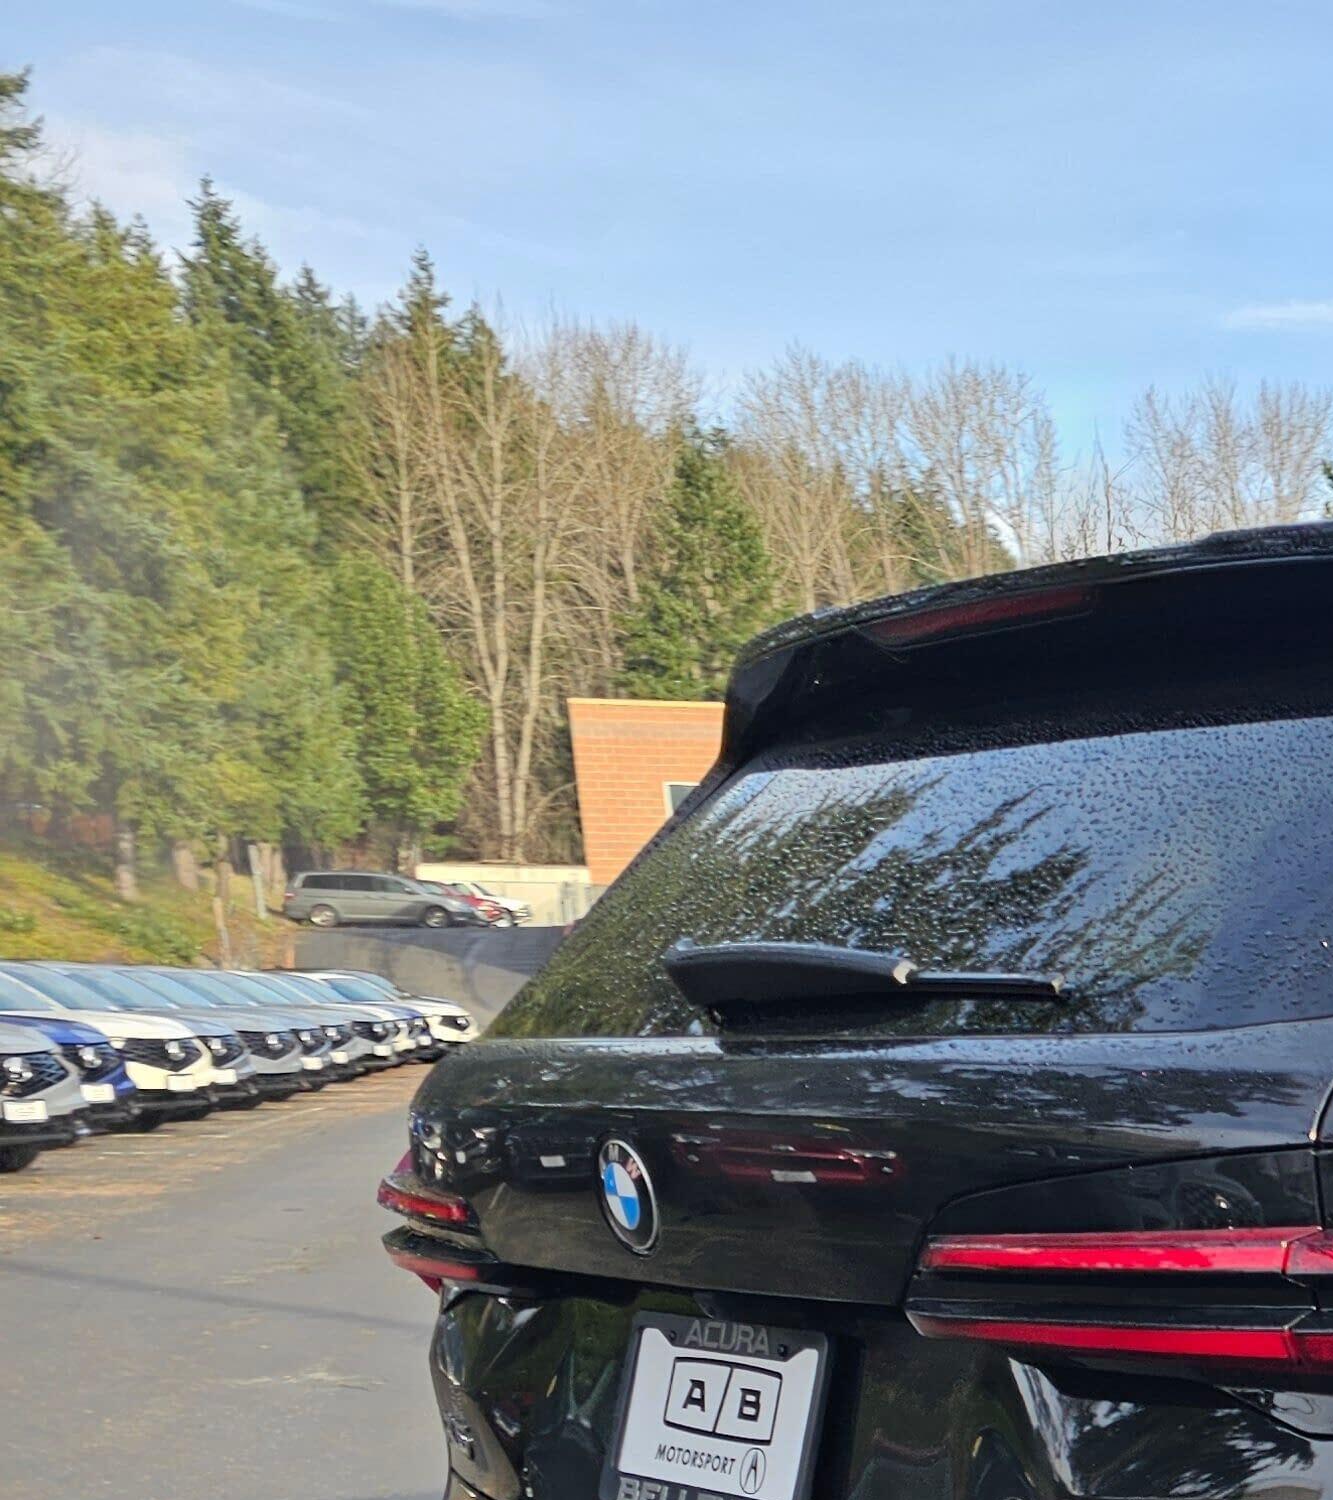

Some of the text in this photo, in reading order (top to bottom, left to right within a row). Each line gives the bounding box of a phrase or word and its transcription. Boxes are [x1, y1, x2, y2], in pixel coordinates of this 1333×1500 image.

[684, 1319, 770, 1355] ACURA
[682, 1379, 762, 1422] A B
[654, 1443, 736, 1475] MOTORSPORT
